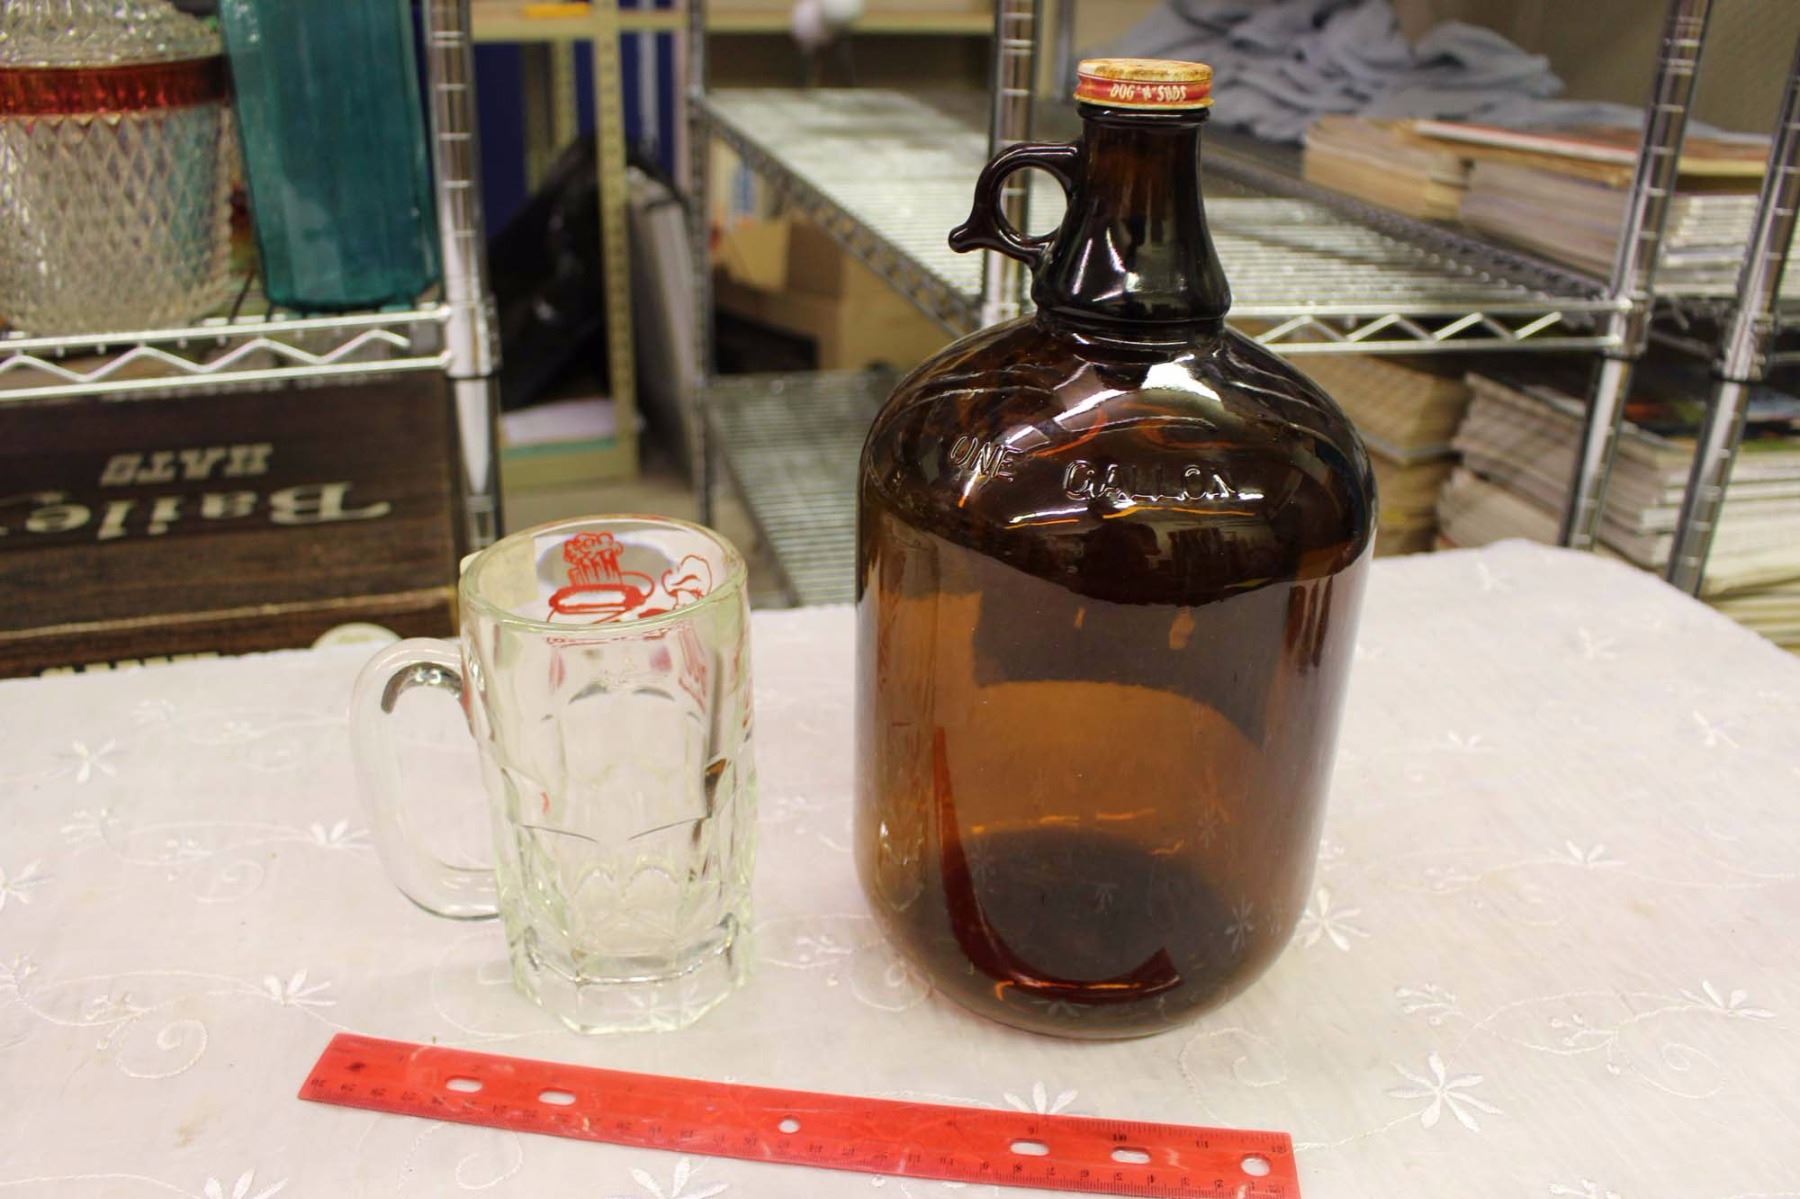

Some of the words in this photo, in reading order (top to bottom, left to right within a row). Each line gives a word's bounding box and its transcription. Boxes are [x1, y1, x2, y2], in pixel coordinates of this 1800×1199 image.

[1110, 83, 1134, 100] DOG
[1157, 85, 1187, 101] SUDS
[100, 442, 273, 487] HATS
[950, 435, 1020, 481] ONE
[0, 481, 391, 540] Baile
